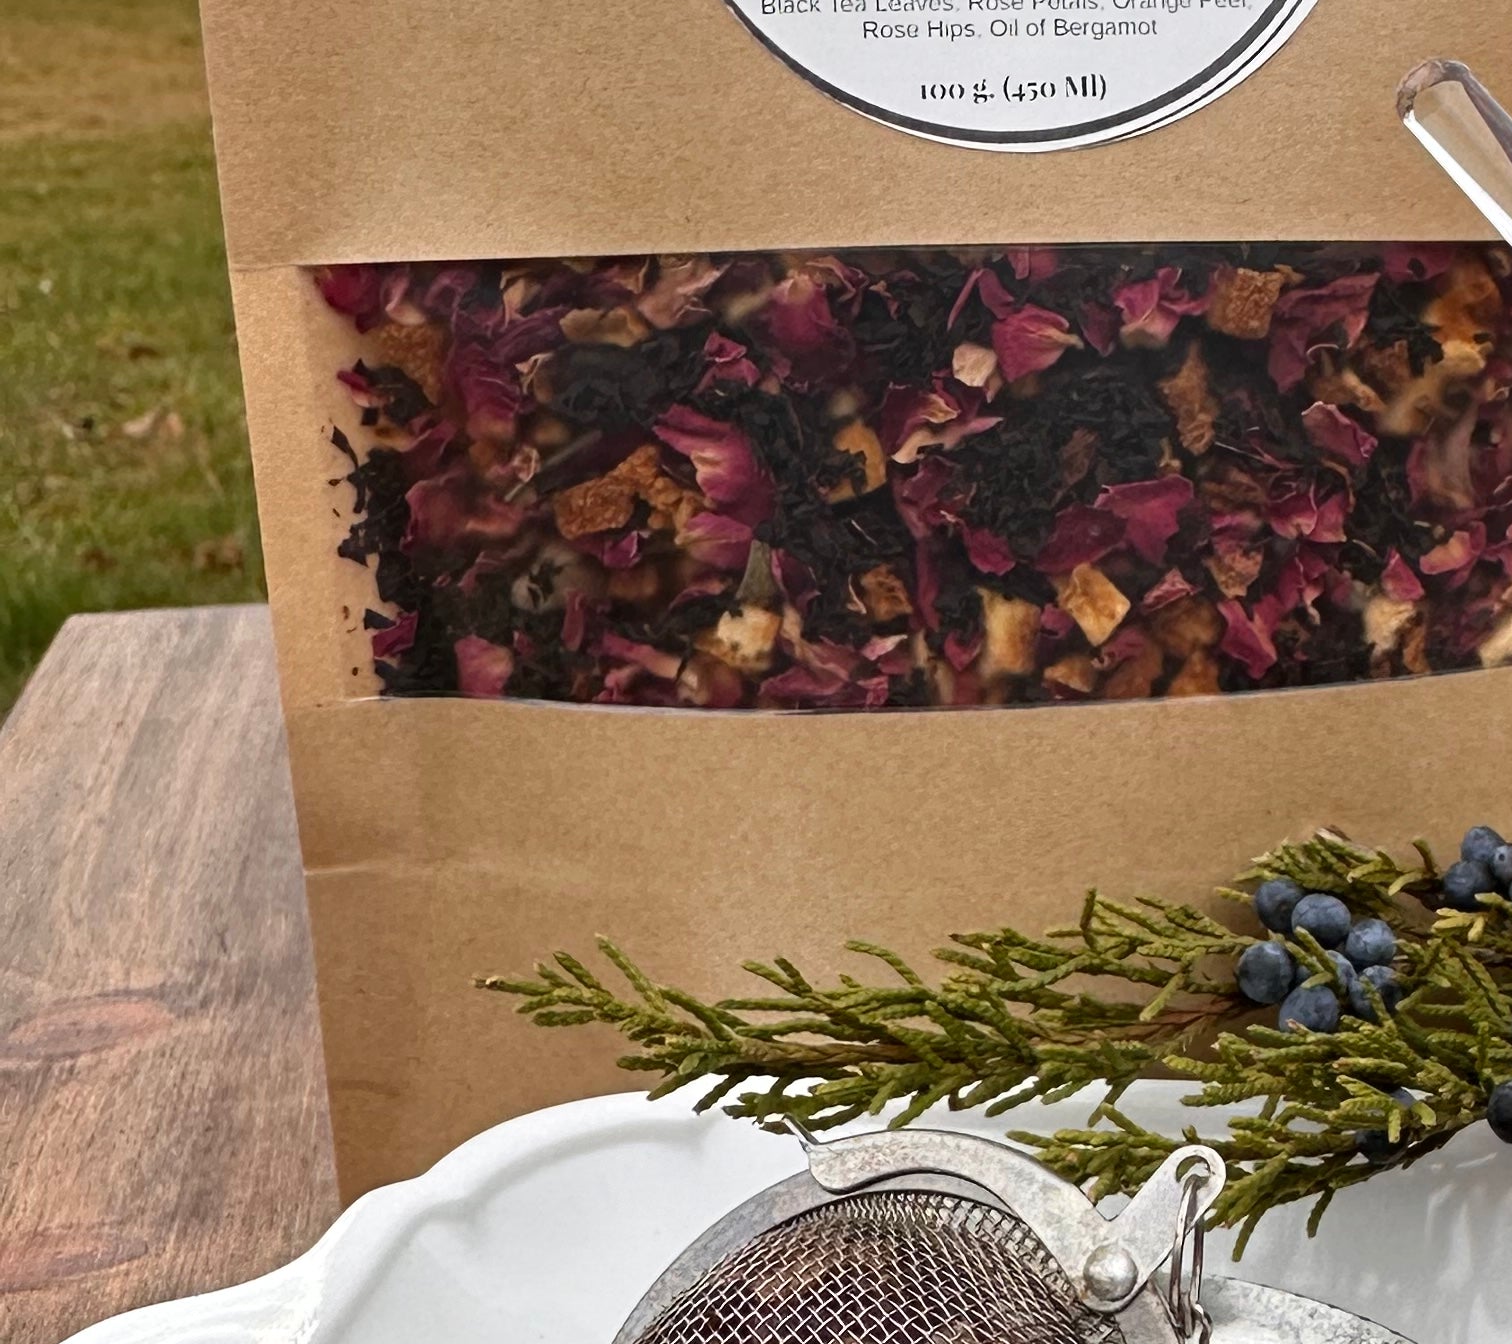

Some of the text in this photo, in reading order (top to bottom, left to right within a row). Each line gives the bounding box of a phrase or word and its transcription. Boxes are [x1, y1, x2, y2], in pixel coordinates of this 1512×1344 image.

[862, 20, 919, 39] Rose
[989, 18, 1019, 37] Oil
[1026, 18, 1046, 37] of
[1053, 18, 1158, 41] Bergamot
[920, 83, 965, 100] 100
[1003, 75, 1056, 102] (450
